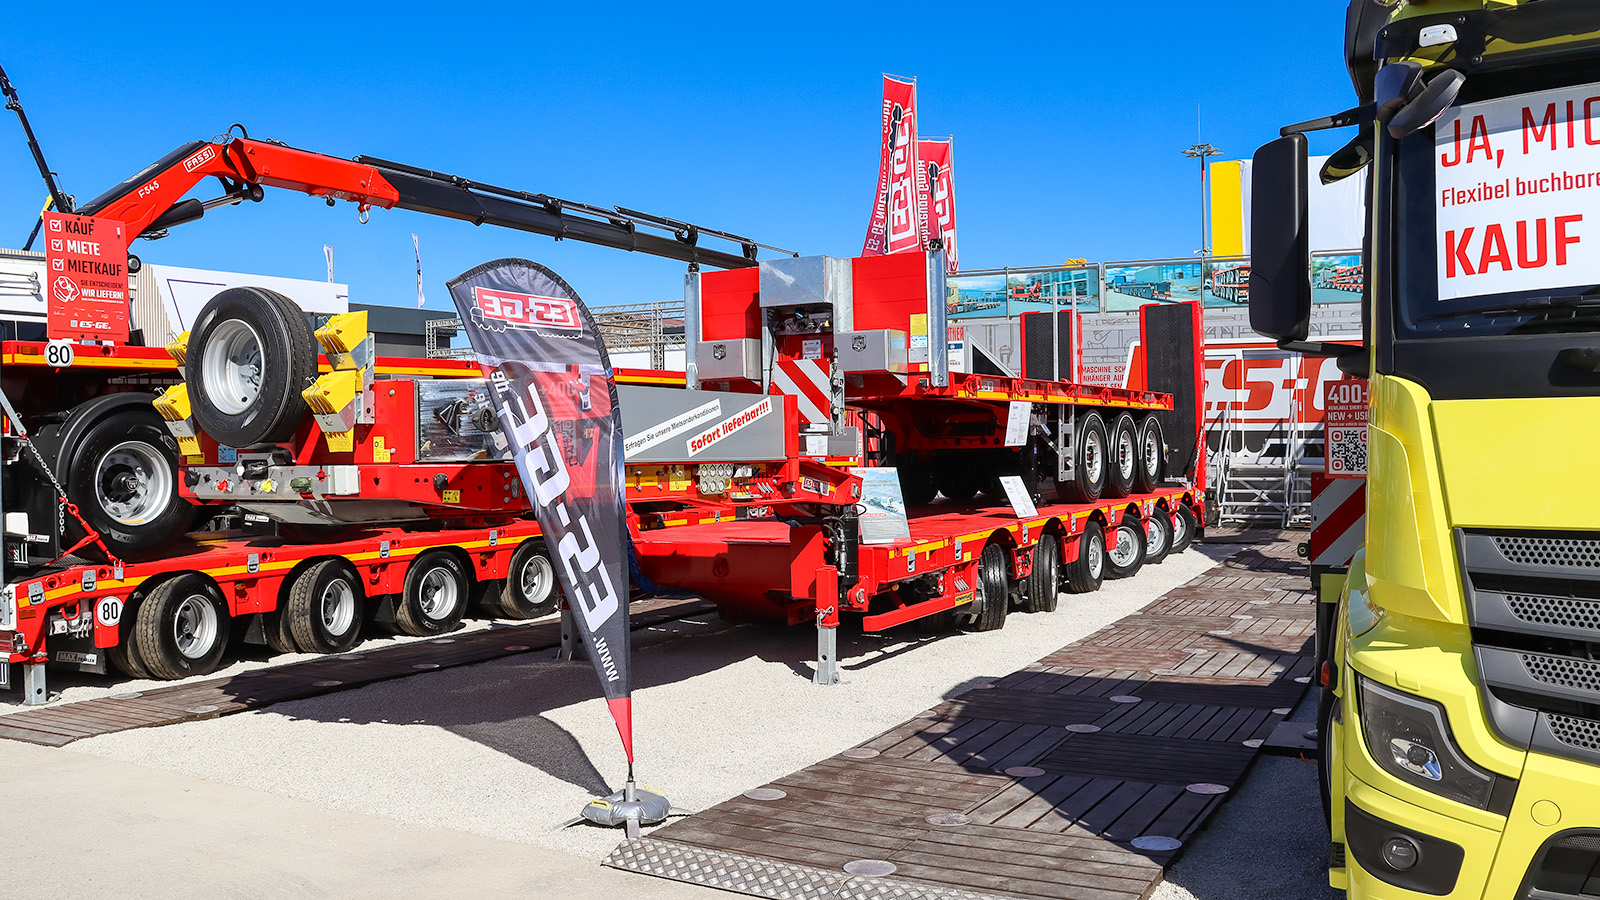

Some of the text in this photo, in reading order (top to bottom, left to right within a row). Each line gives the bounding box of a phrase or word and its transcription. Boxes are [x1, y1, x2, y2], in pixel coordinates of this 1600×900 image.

[1441, 114, 1505, 169] JA,
[186, 148, 213, 170] FASSI
[138, 180, 160, 199] F545
[1442, 178, 1510, 208] Flexibel
[65, 220, 95, 236] KAUF
[66, 239, 101, 256] MIETE
[1445, 213, 1584, 279] KAUF
[68, 259, 122, 277] MIETKAUF
[80, 279, 88, 287] SIE
[81, 288, 124, 300] WIR LIEFERN!
[49, 345, 71, 364] 80
[1328, 411, 1346, 420] NEW
[625, 404, 720, 452] Erfragen Sie unsere Mietsonderkonditionen
[690, 401, 770, 453] Sofort lieferbar!!!
[102, 601, 119, 621] 80
